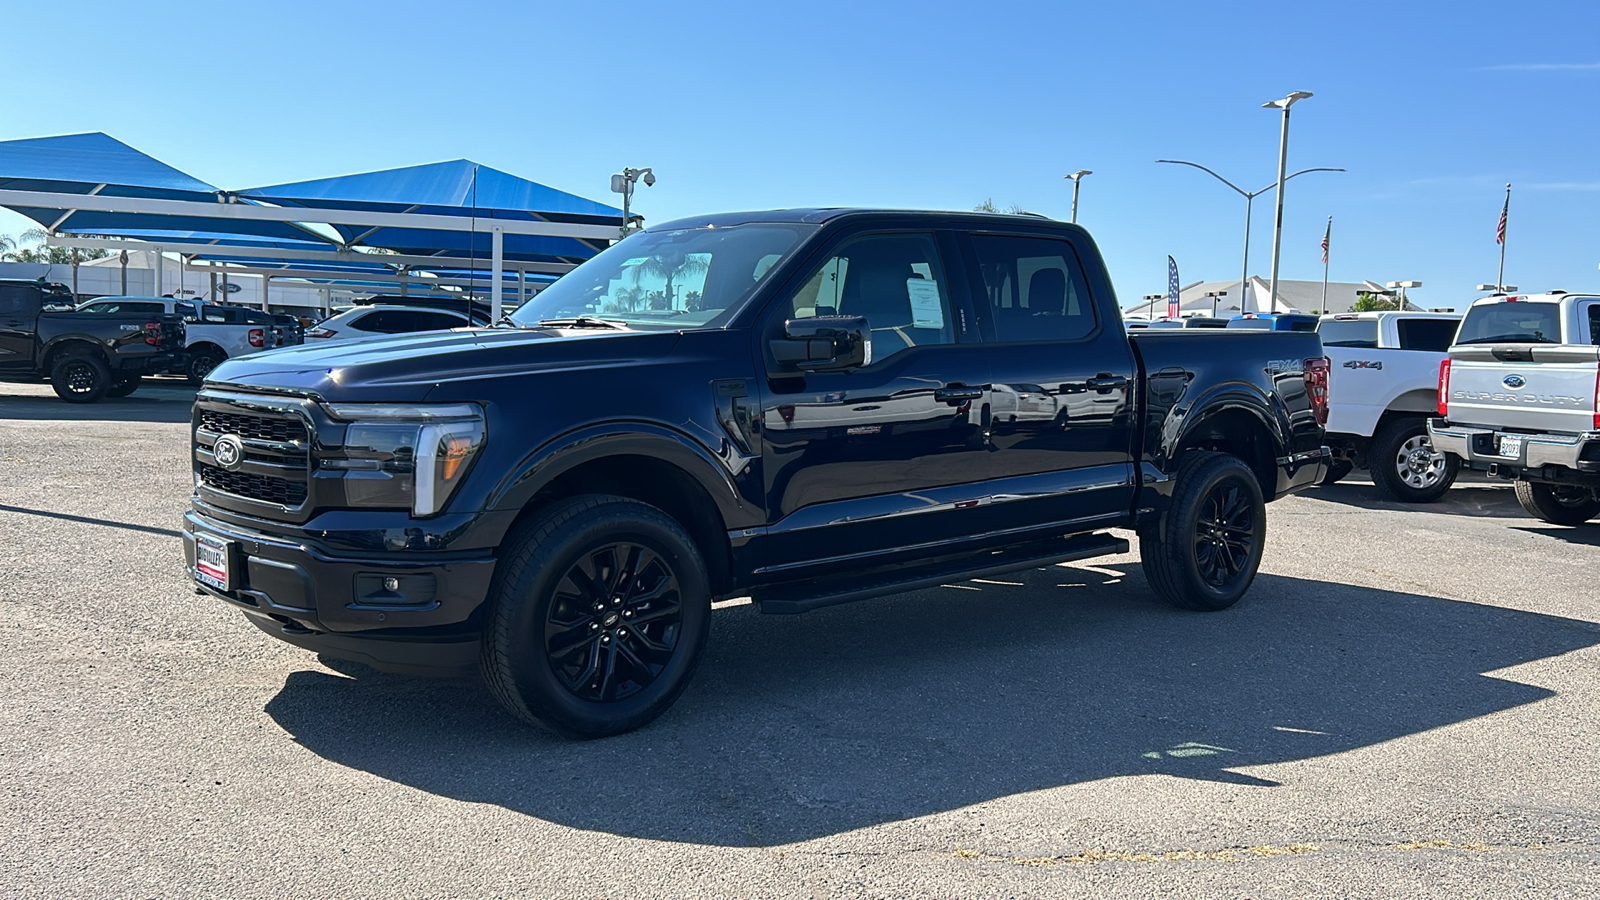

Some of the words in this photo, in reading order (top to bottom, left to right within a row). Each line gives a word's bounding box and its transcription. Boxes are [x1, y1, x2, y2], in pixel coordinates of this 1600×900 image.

[1267, 360, 1302, 376] FX4
[1454, 391, 1519, 403] SUPER
[1523, 394, 1586, 406] DUTY
[217, 442, 234, 462] Ford
